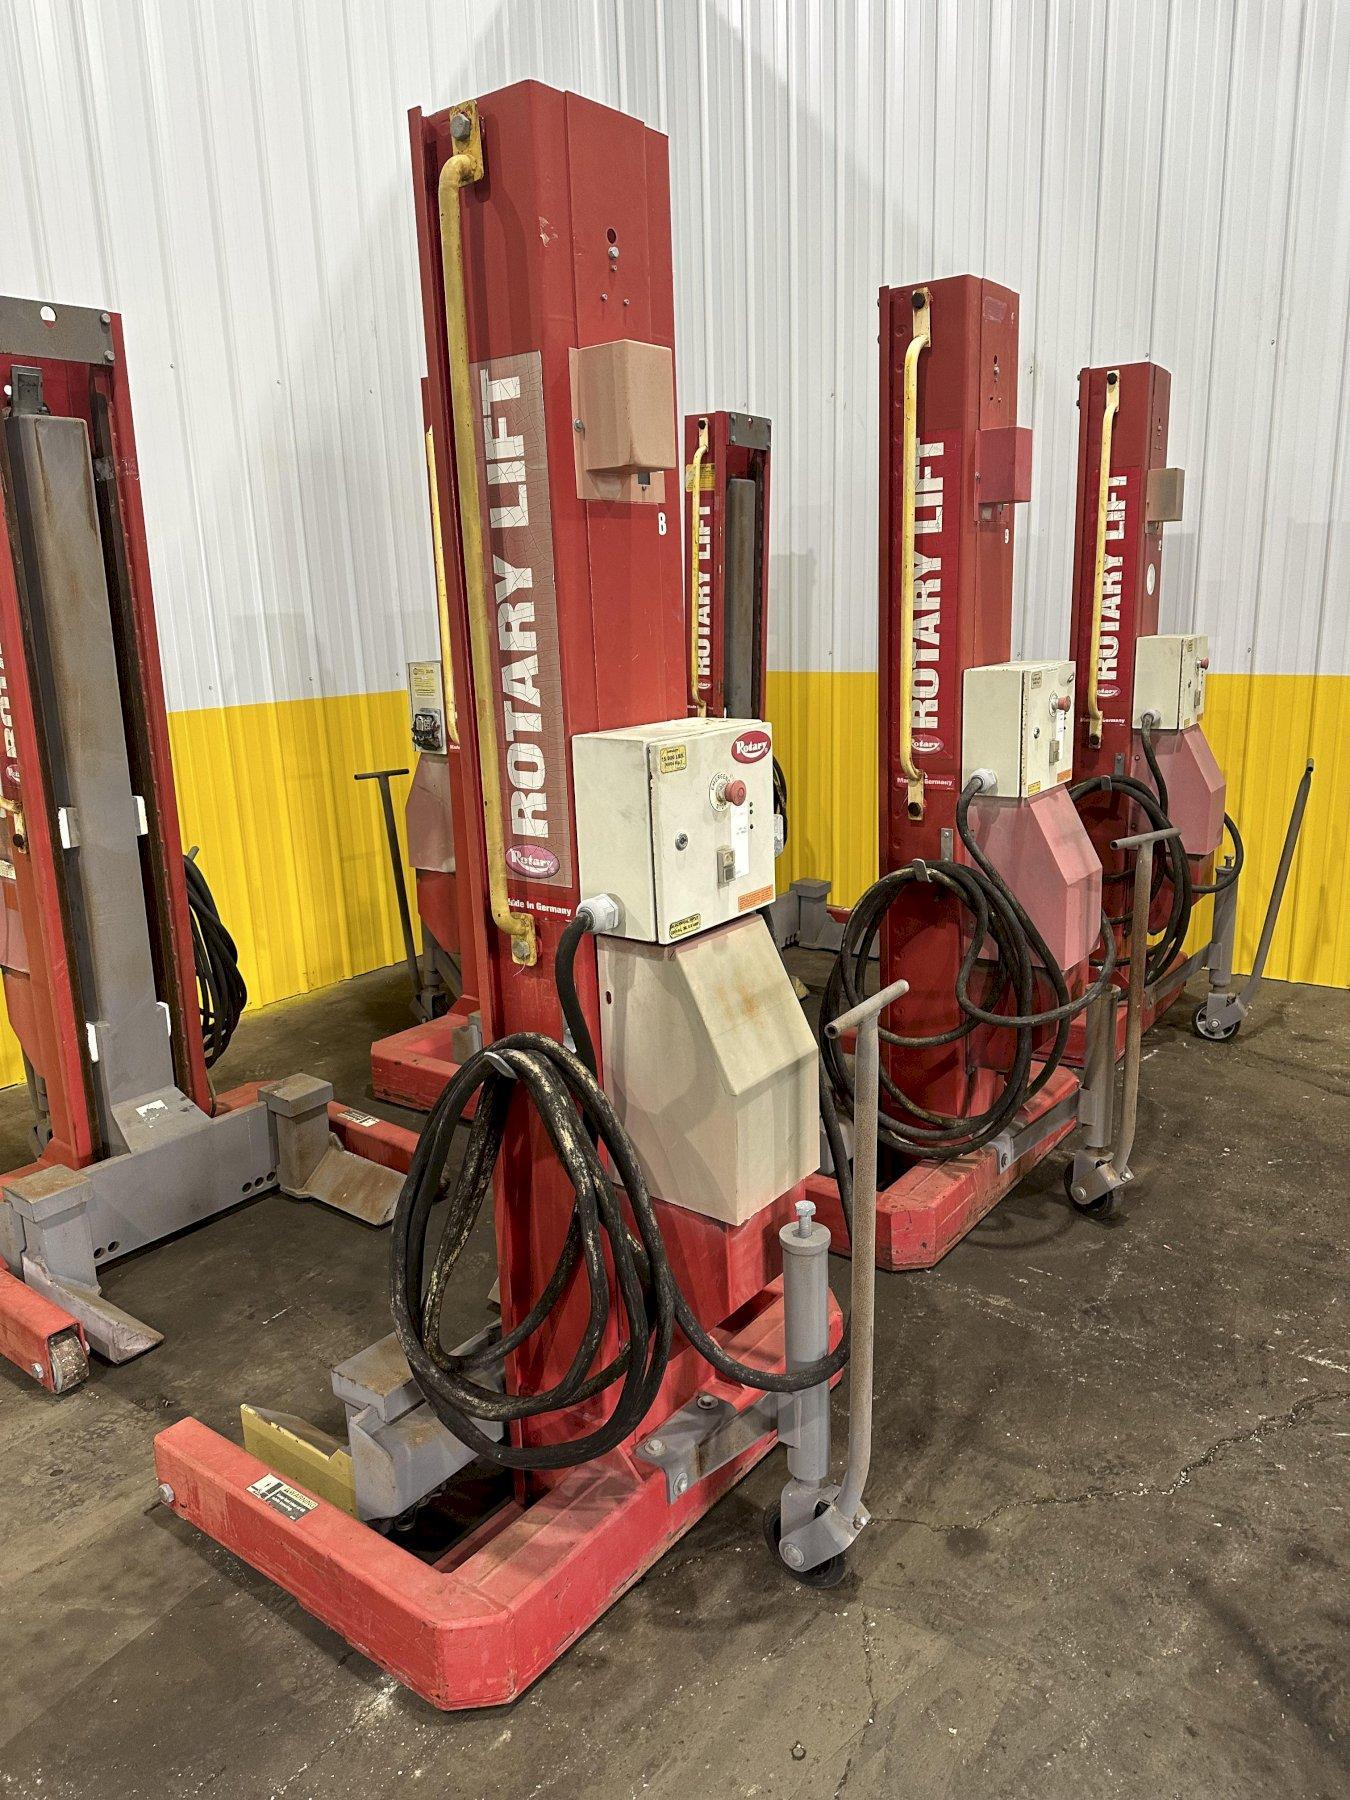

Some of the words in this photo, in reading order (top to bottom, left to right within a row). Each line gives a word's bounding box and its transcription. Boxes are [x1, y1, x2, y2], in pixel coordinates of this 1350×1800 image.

[480, 368, 529, 528] LIFT
[914, 437, 945, 535] LIFT
[911, 551, 942, 729] ROTARY
[492, 555, 550, 838] ROTARY
[735, 740, 768, 758] Rotary
[911, 738, 941, 752] otary
[509, 848, 554, 873] Rotary
[536, 902, 572, 916] Germany
